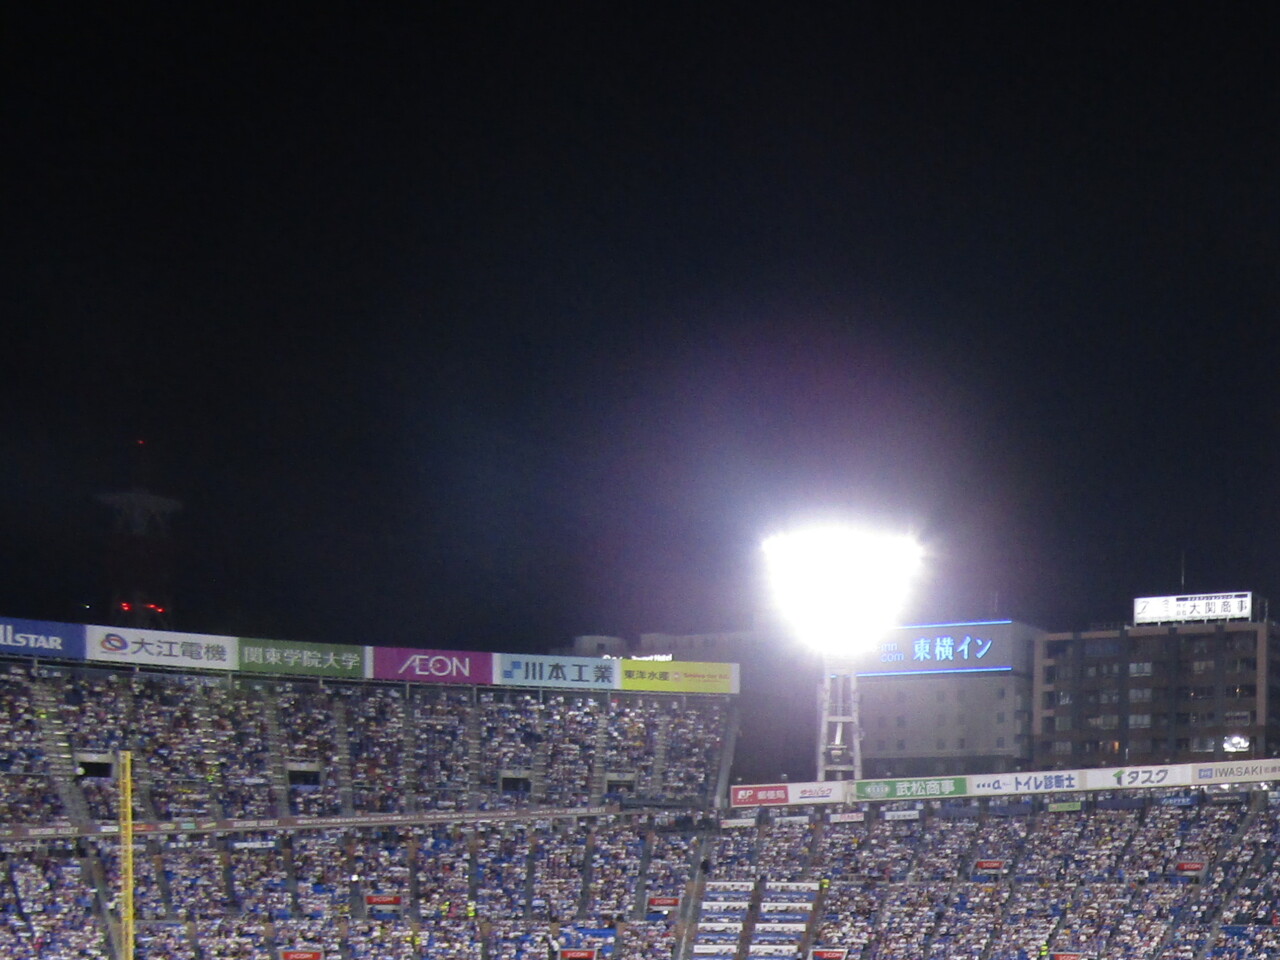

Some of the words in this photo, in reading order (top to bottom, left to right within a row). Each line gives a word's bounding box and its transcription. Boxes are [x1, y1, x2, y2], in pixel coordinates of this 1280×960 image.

[131, 637, 227, 663] 大江電機
[913, 636, 992, 661] 東横イン
[243, 646, 361, 670] 関東学院大学
[524, 661, 613, 683] 川本工業
[624, 669, 670, 681] 東洋水産
[1127, 769, 1169, 785] タスク
[1214, 765, 1263, 778] IWASAKI
[895, 779, 956, 797] 武松商事
[1014, 774, 1076, 791] トイレ診断士
[757, 789, 786, 801] 郵便局
